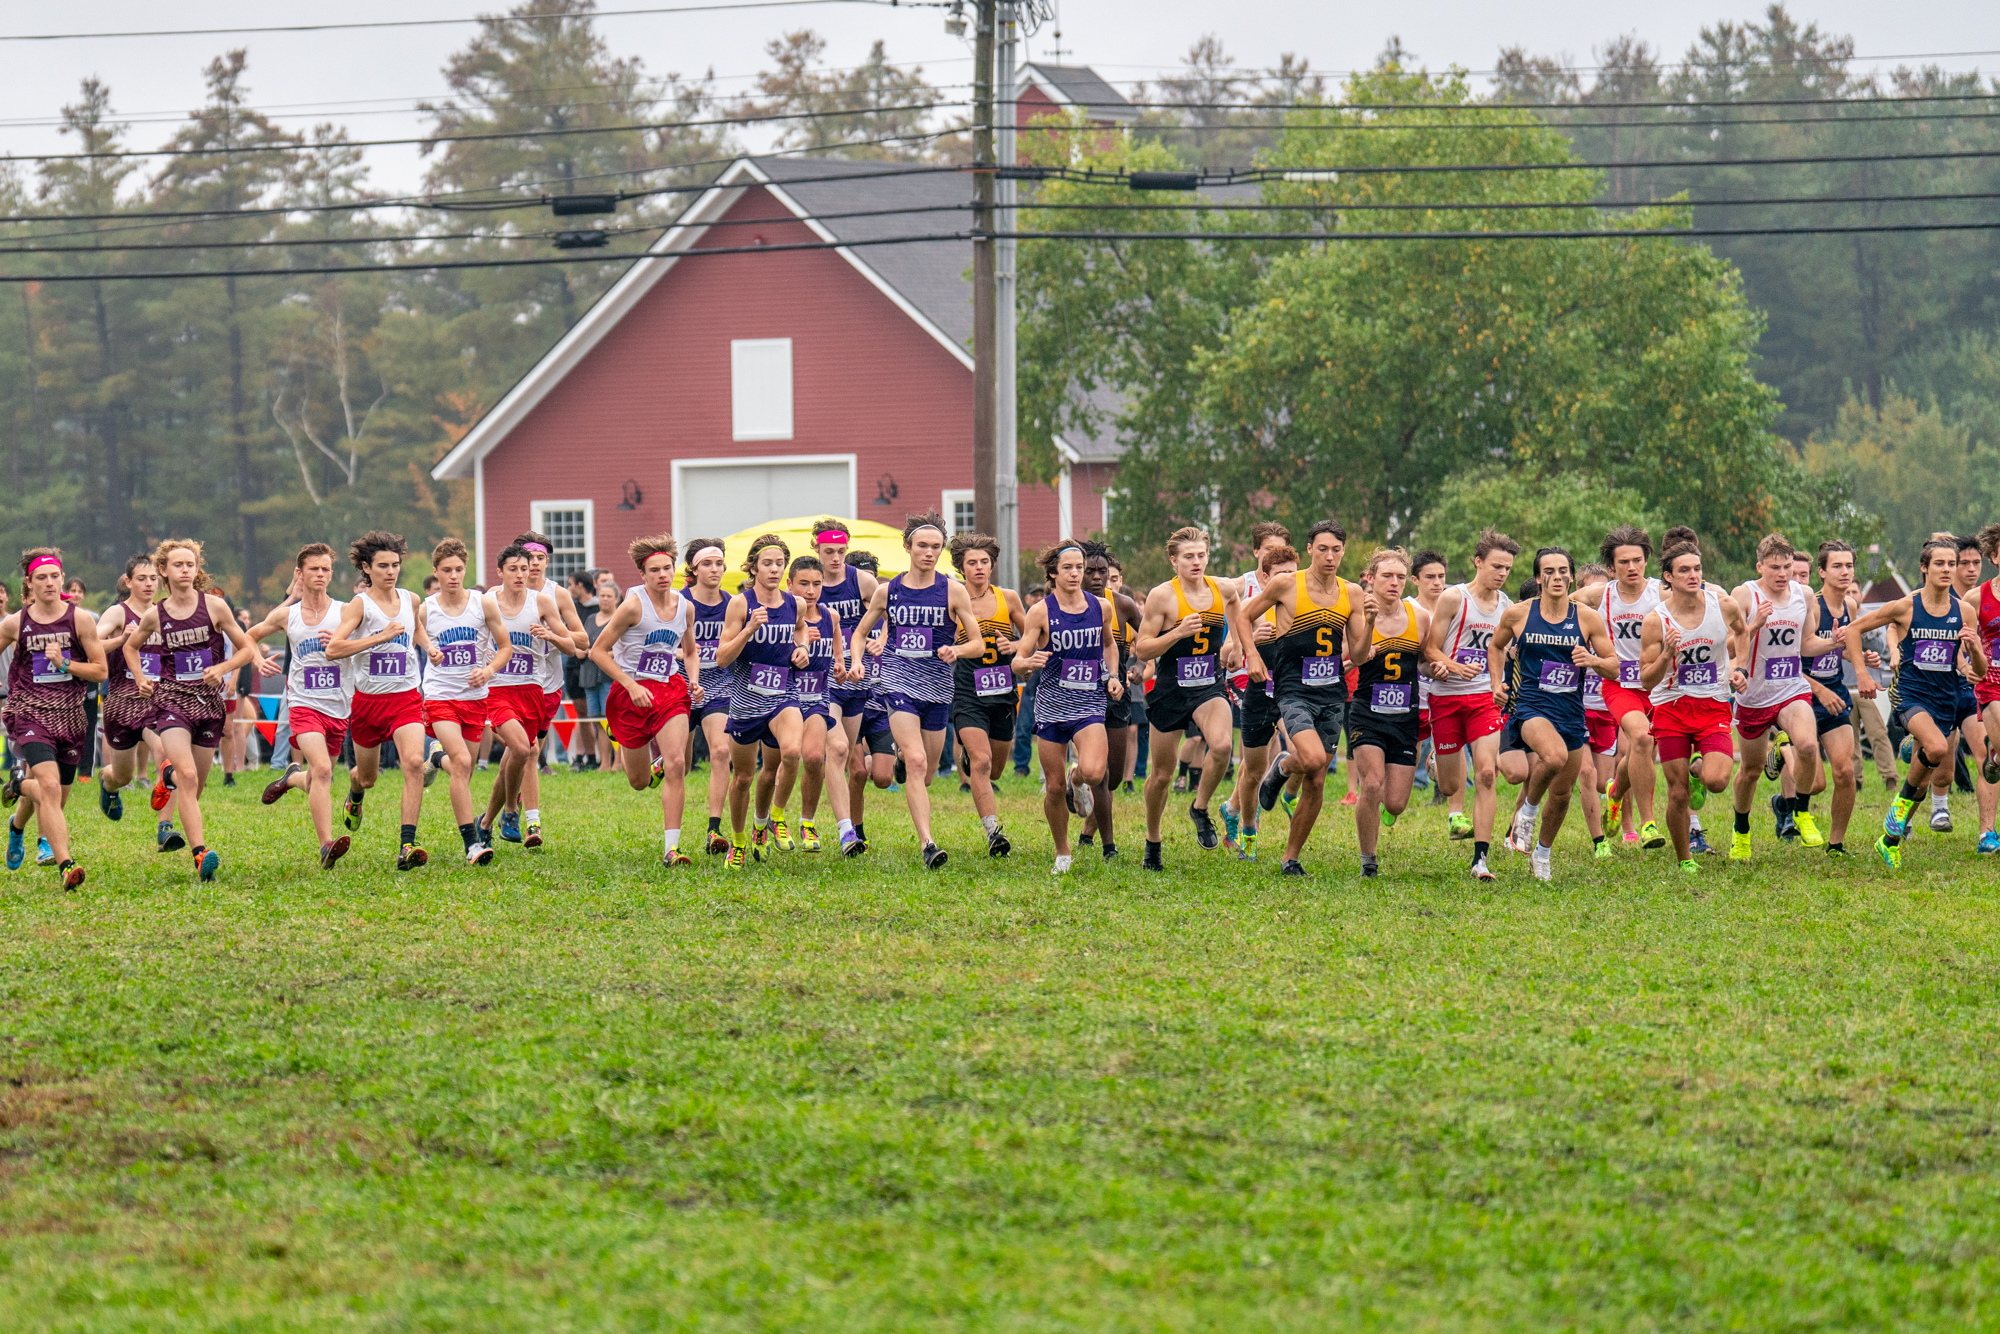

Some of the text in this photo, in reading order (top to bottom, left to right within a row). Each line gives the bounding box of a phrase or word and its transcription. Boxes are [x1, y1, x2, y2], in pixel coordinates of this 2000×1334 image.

[888, 605, 946, 626] SOUTH
[1612, 613, 1644, 623] PINKERTO
[1766, 620, 1798, 628] PINKERTON
[900, 634, 926, 649] 230
[1050, 626, 1102, 652] SOUTH
[1192, 626, 1210, 655] S
[1316, 628, 1333, 656] S
[1525, 632, 1580, 646] WINDHAM
[1676, 638, 1714, 652] PINKERTON
[1767, 628, 1796, 646] XC
[447, 650, 472, 665] 169
[982, 636, 998, 664] S
[1680, 645, 1711, 664] XC
[1920, 648, 1948, 662] 484
[186, 658, 204, 672] 12
[376, 660, 400, 674] 171
[644, 658, 668, 674] 183
[1184, 662, 1210, 678] 507
[1308, 662, 1334, 677] 505
[1384, 652, 1402, 680] S
[1770, 662, 1794, 678] 371
[1817, 655, 1839, 670] 478
[310, 672, 335, 688] 166
[754, 670, 782, 688] 216
[980, 672, 1006, 689] 916
[1066, 666, 1092, 681] 215
[1546, 669, 1575, 686] 457
[1684, 669, 1712, 684] 364
[1378, 690, 1405, 706] 508
